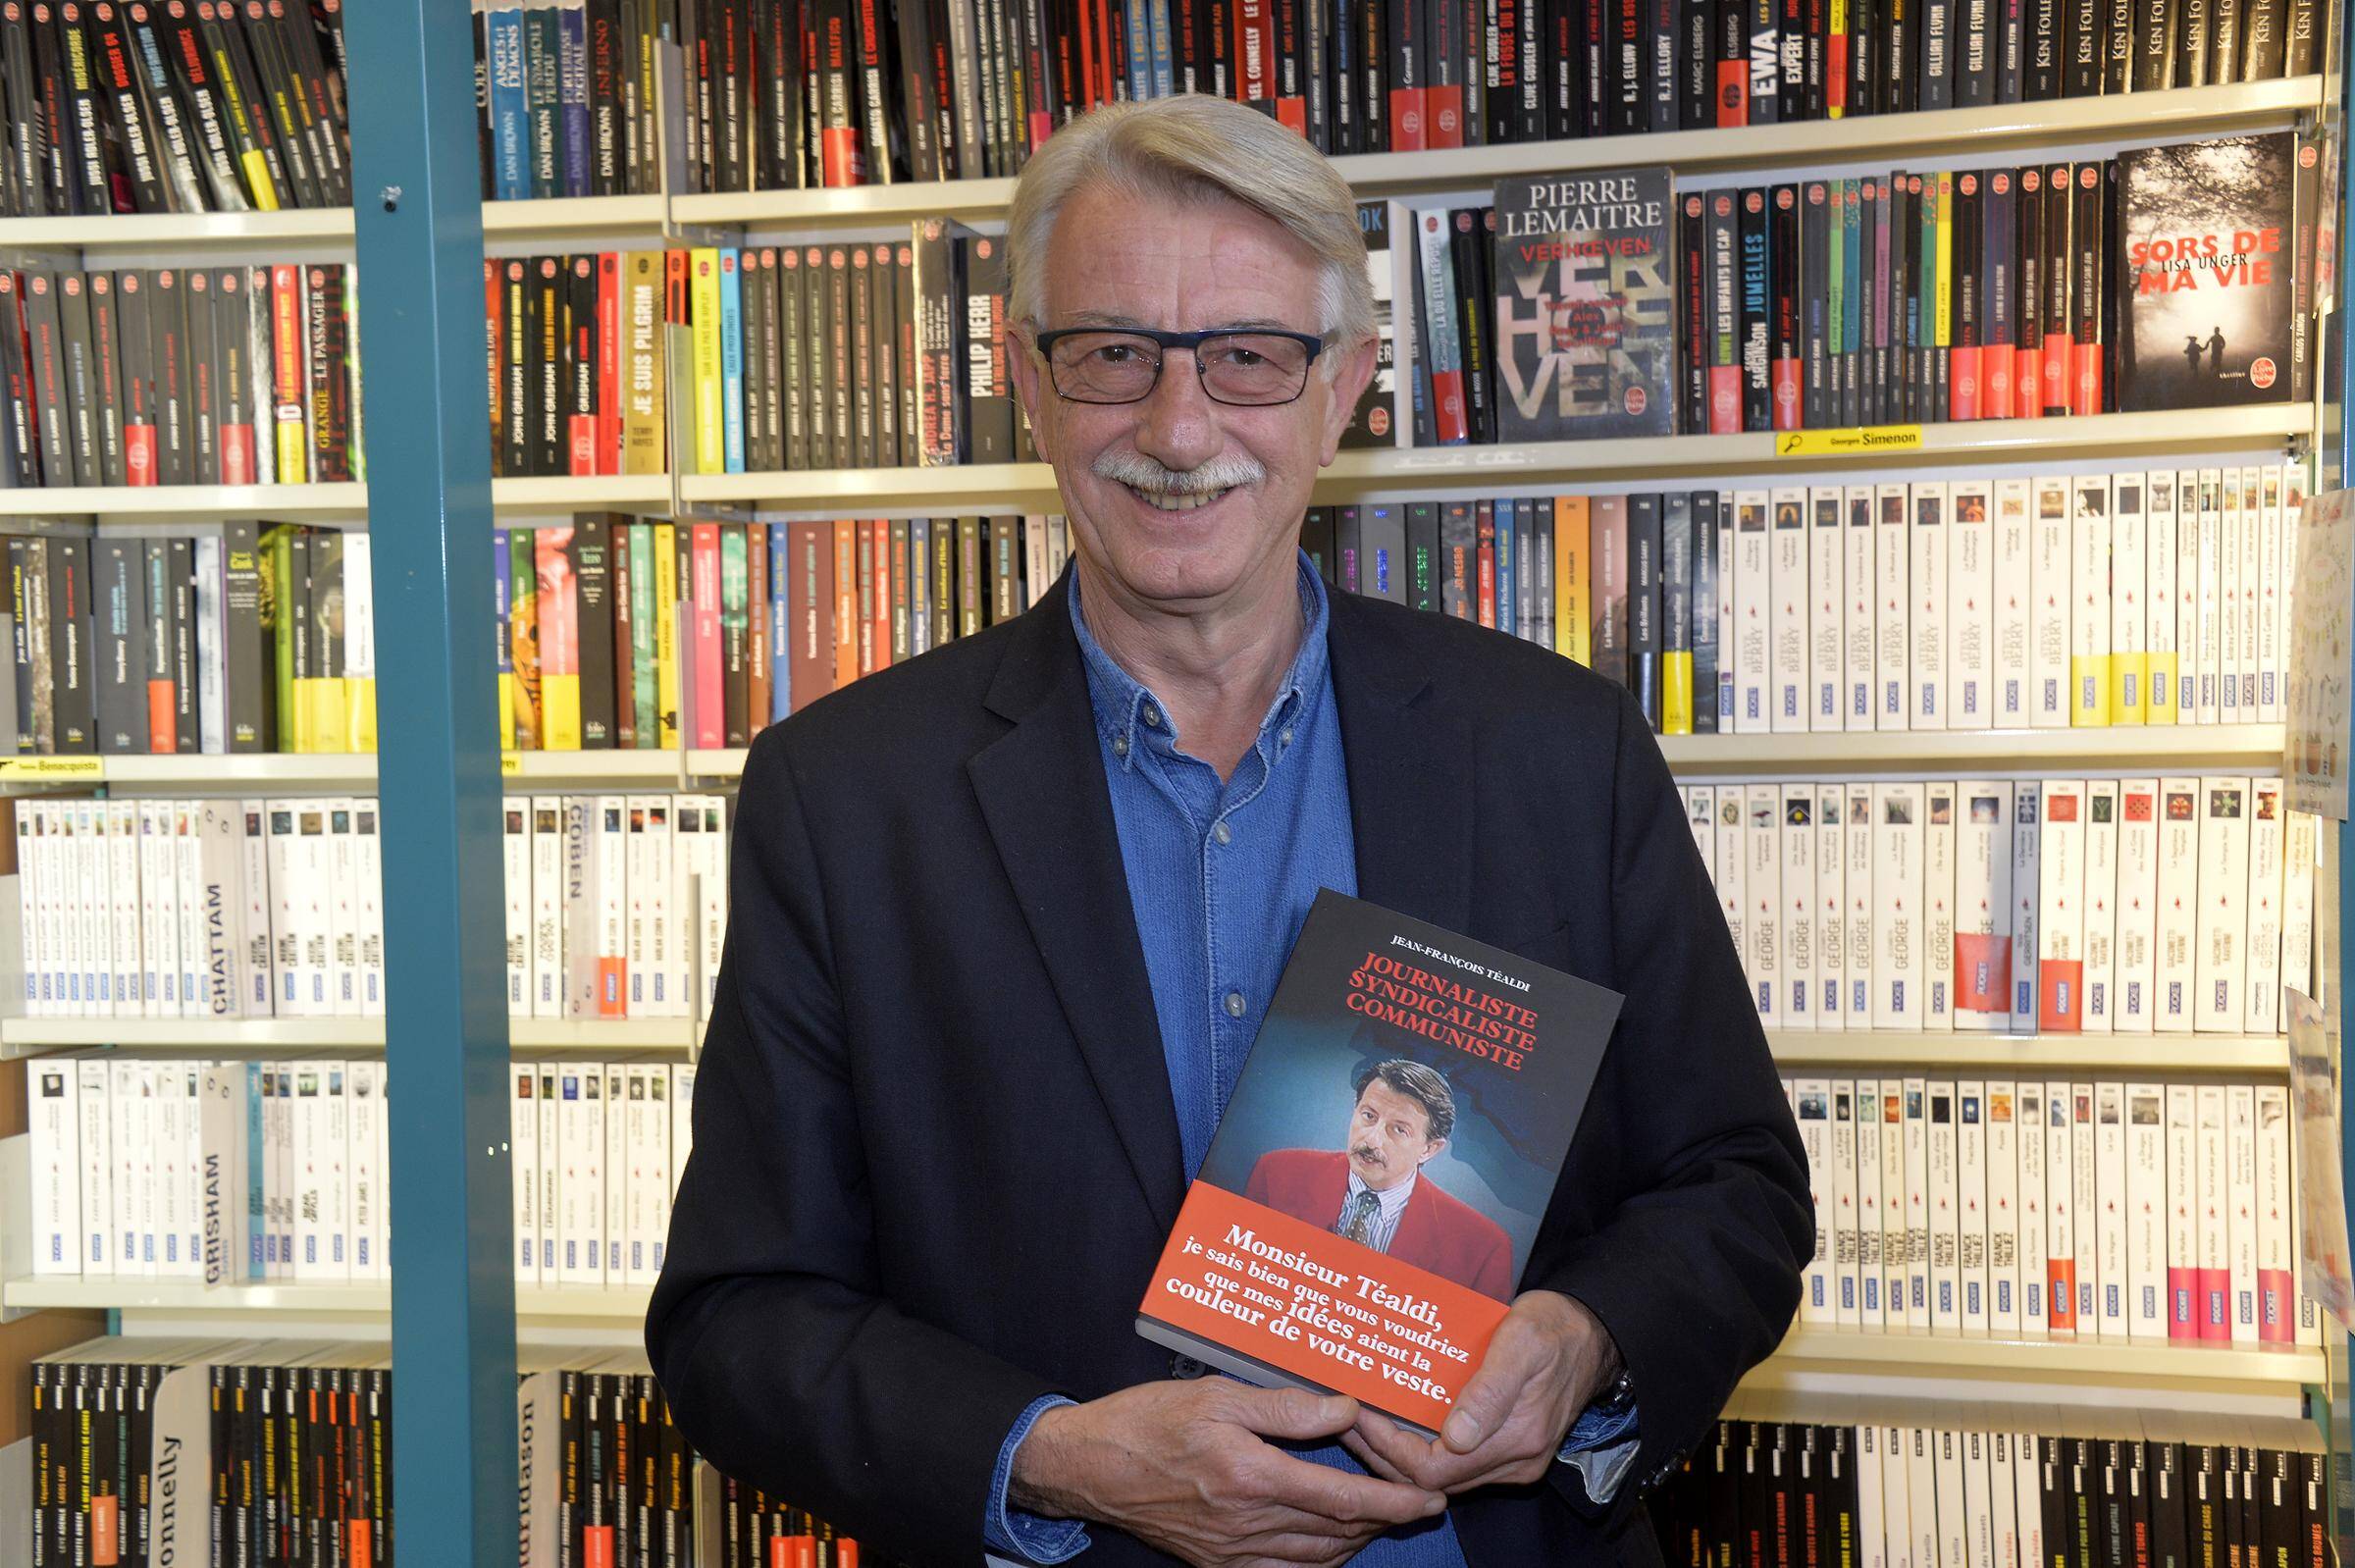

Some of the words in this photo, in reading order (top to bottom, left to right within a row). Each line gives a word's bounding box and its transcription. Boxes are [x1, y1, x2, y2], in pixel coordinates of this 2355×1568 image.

[1498, 13, 1515, 27] DU
[1930, 5, 1944, 35] FLYNN
[2079, 0, 2094, 30] FOLL
[2295, 12, 2312, 39] KEN
[596, 18, 611, 95] INFERNO
[828, 18, 842, 68] MALEFICO
[1244, 27, 1261, 78] CONNELLY
[1499, 33, 1515, 67] FOSSE
[1657, 34, 1672, 77] ELLORY
[1693, 15, 1703, 59] ELSBERG
[1728, 14, 1739, 59] ELSBERG
[1968, 33, 1983, 71] GILLIAN
[2036, 39, 2051, 67] KEN
[2077, 36, 2093, 63] KEN
[2112, 31, 2127, 59] KEN
[2149, 27, 2165, 54] KEN
[2187, 24, 2202, 50] KEN
[108, 48, 130, 87] DOSSIER
[495, 39, 506, 87] ANGES
[1487, 65, 1500, 87] CLIVE
[1500, 72, 1515, 85] LA
[1622, 43, 1637, 78] ELLORY
[1694, 62, 1703, 94] MARC
[1751, 29, 1777, 96] EWA
[1786, 33, 1803, 83] EXPERT
[1929, 39, 1944, 77] GILLIAN
[866, 69, 880, 107] CARRISI
[1524, 83, 1538, 110] CLIVE
[77, 99, 100, 159] ADLER-OLSEN
[119, 93, 147, 155] ADLER-OLSEN
[158, 96, 187, 155] ADLER-OLSEN
[194, 88, 225, 150] ADLER-OLSEN
[503, 112, 516, 154] BROWN
[539, 109, 552, 153] BROWN
[598, 106, 612, 149] BROWN
[85, 161, 104, 185] JUSSI
[135, 156, 155, 182] JUSSI
[504, 157, 518, 181] DAN
[541, 154, 553, 179] DAN
[601, 152, 613, 176] DAN
[1530, 179, 1638, 209] PIERRE
[1505, 202, 1663, 236] LEMAITRE
[1716, 229, 1730, 249] CAP
[1717, 251, 1730, 265] DU
[2131, 235, 2218, 266] SORS
[2234, 228, 2280, 254] DE
[2162, 258, 2190, 273] LISA
[2199, 253, 2248, 269] UNGER
[1717, 267, 1731, 312] ENFANTS
[1745, 234, 1764, 312] JUMELLES
[2139, 272, 2198, 294] MA
[2209, 261, 2272, 287] VIE
[311, 291, 327, 358] PASSAGER
[633, 286, 653, 349] PILGRIM
[1718, 315, 1731, 333] LES
[315, 361, 327, 378] LE
[635, 354, 653, 390] SUIS
[922, 355, 935, 385] JAPP
[970, 344, 992, 397] PHILIP
[1752, 322, 1767, 389] SARGINSON
[512, 366, 524, 413] GRISHAM
[545, 363, 556, 412] GRISHAM
[579, 363, 590, 412] GRISHAM
[635, 395, 653, 415] JE
[513, 414, 524, 445] JOHN
[546, 413, 556, 443] JOHN
[1862, 432, 1916, 445] Simenon
[1751, 627, 1763, 673] BERRY
[1787, 626, 1801, 672] BERRY
[1824, 624, 1838, 671] BERRY
[570, 805, 582, 899] COBEN
[207, 883, 228, 1015] CHATTAM
[1760, 920, 1774, 970] GEORGE
[1796, 918, 1809, 969] GEORGE
[1827, 917, 1841, 968] GEORGE
[2024, 916, 2033, 967] GERRITSEN
[1390, 935, 1485, 975] JEAN-FRANÇOIS
[1487, 968, 1531, 992] TÉALDI
[1349, 969, 1537, 1052] SYNDICALISTE
[1360, 952, 1539, 1028] JOURNALISTE
[1346, 992, 1524, 1071] COMMUNISTE
[205, 1154, 220, 1283] GRISHAM
[1934, 1232, 1944, 1267] FRANCK
[1944, 1233, 1955, 1267] THILLIEZ
[1994, 1232, 2003, 1267] FRANCK
[2003, 1232, 2014, 1266] THILLIEZ
[1224, 1224, 1349, 1289] Monsieur
[1356, 1274, 1442, 1332] Téaldi,
[1181, 1235, 1203, 1255] je
[1205, 1247, 1243, 1272] sais
[1248, 1261, 1289, 1290] bien
[1293, 1282, 1330, 1305] que
[1334, 1298, 1378, 1326] vous
[1383, 1318, 1469, 1364] voudriez
[1167, 1278, 1265, 1326] couleur
[1269, 1315, 1301, 1341] de
[1308, 1331, 1374, 1372] votre
[1381, 1361, 1452, 1404] veste.
[1204, 1270, 1239, 1293] que
[1243, 1284, 1283, 1311] mes
[1288, 1297, 1355, 1339] idées
[1357, 1331, 1409, 1363] aient
[1411, 1350, 1433, 1372] la
[158, 1437, 182, 1568] onnelly
